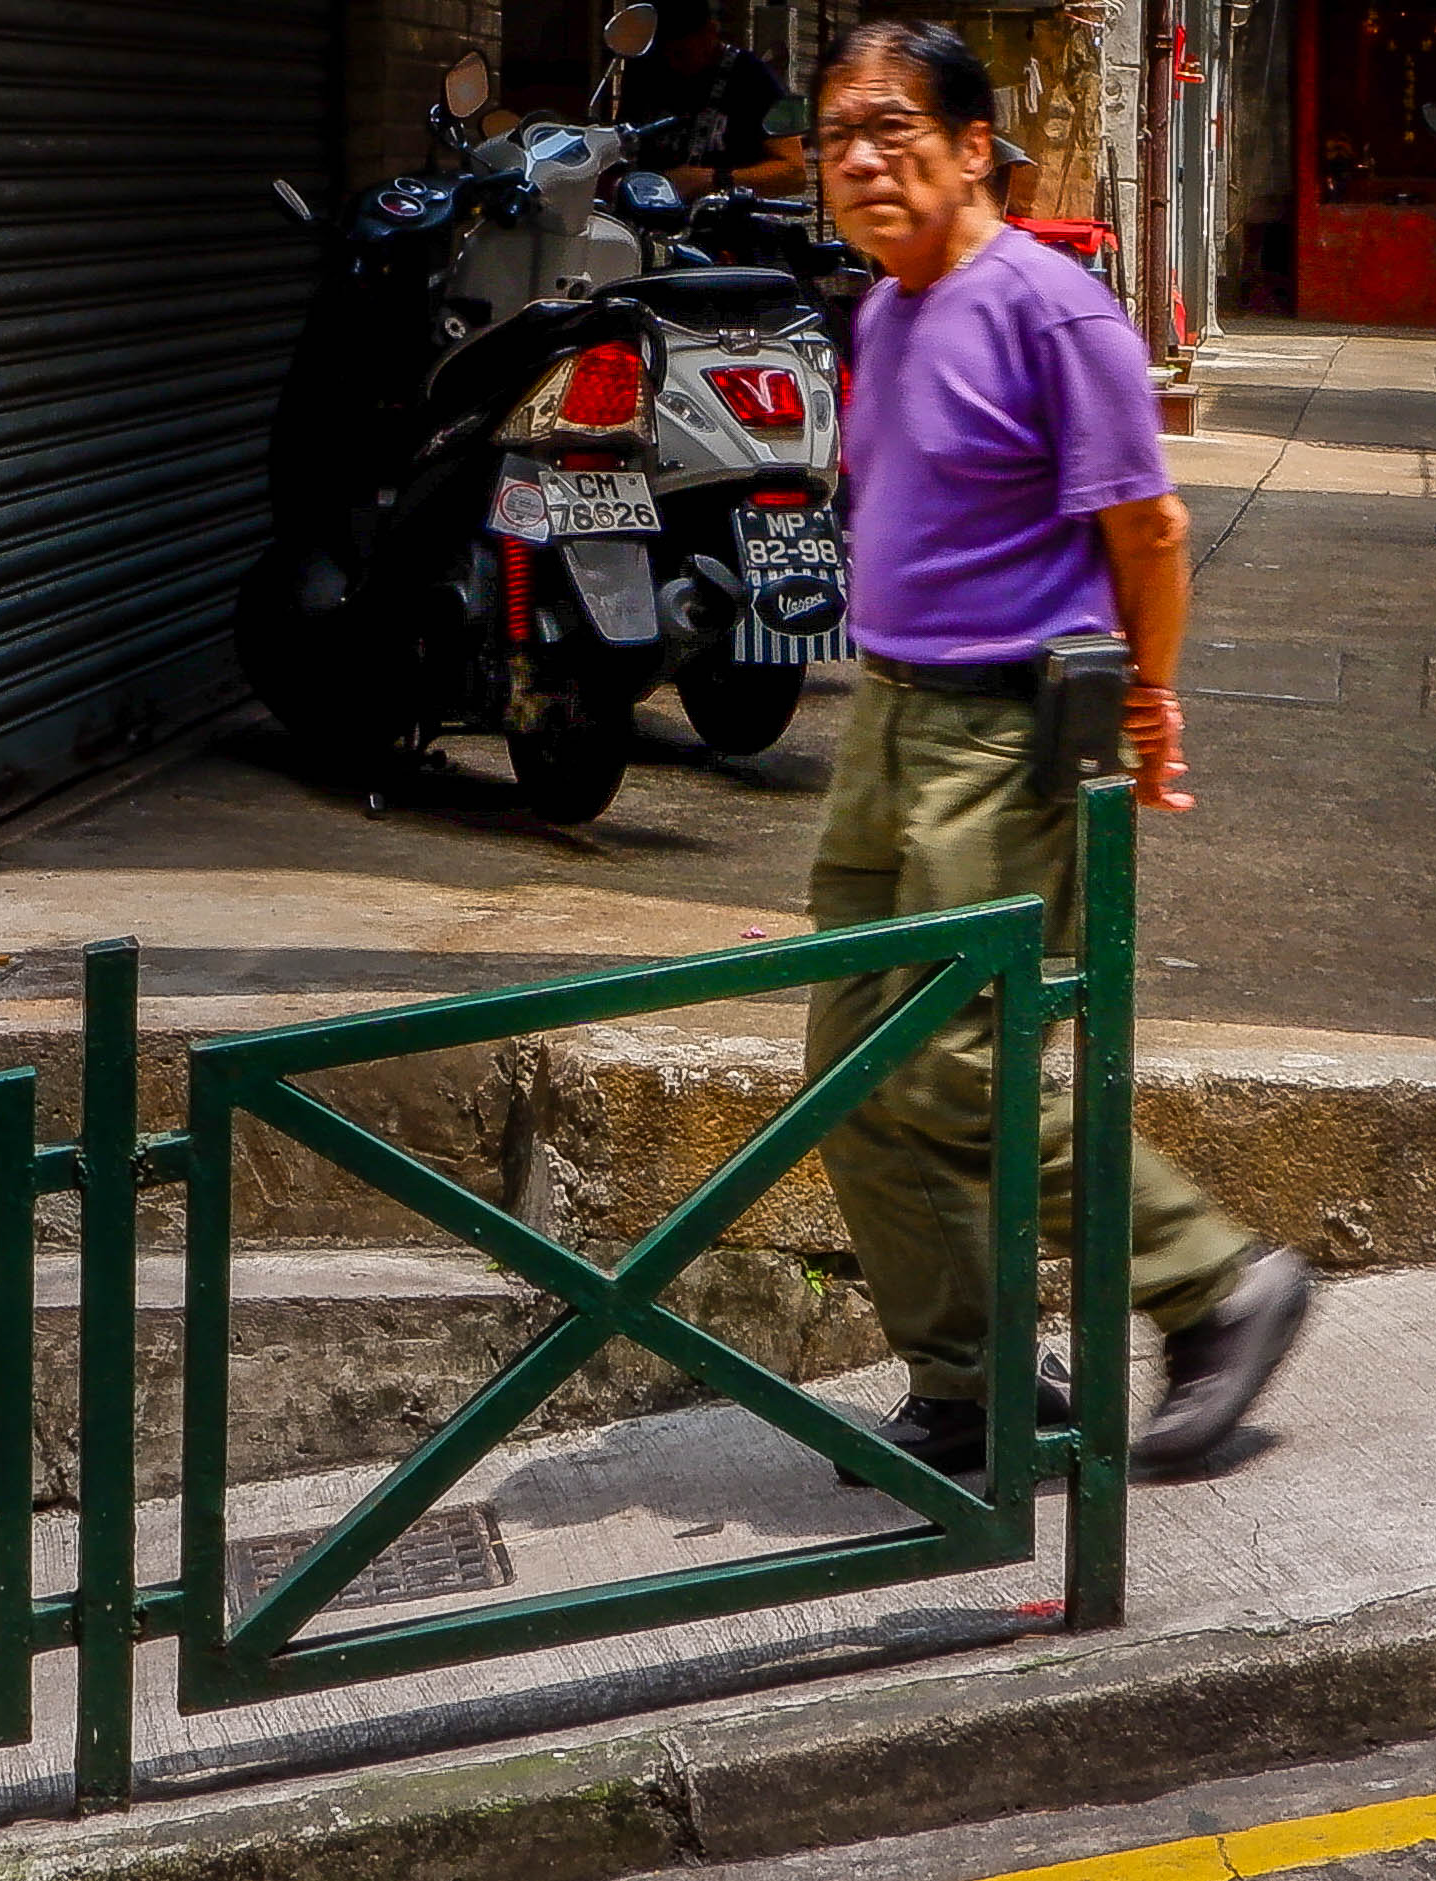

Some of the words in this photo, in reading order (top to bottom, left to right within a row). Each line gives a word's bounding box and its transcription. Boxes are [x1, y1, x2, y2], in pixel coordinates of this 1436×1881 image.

[576, 474, 619, 499] CM
[549, 502, 654, 533] 78626
[764, 512, 806, 537] MP
[746, 539, 838, 564] 82-98
